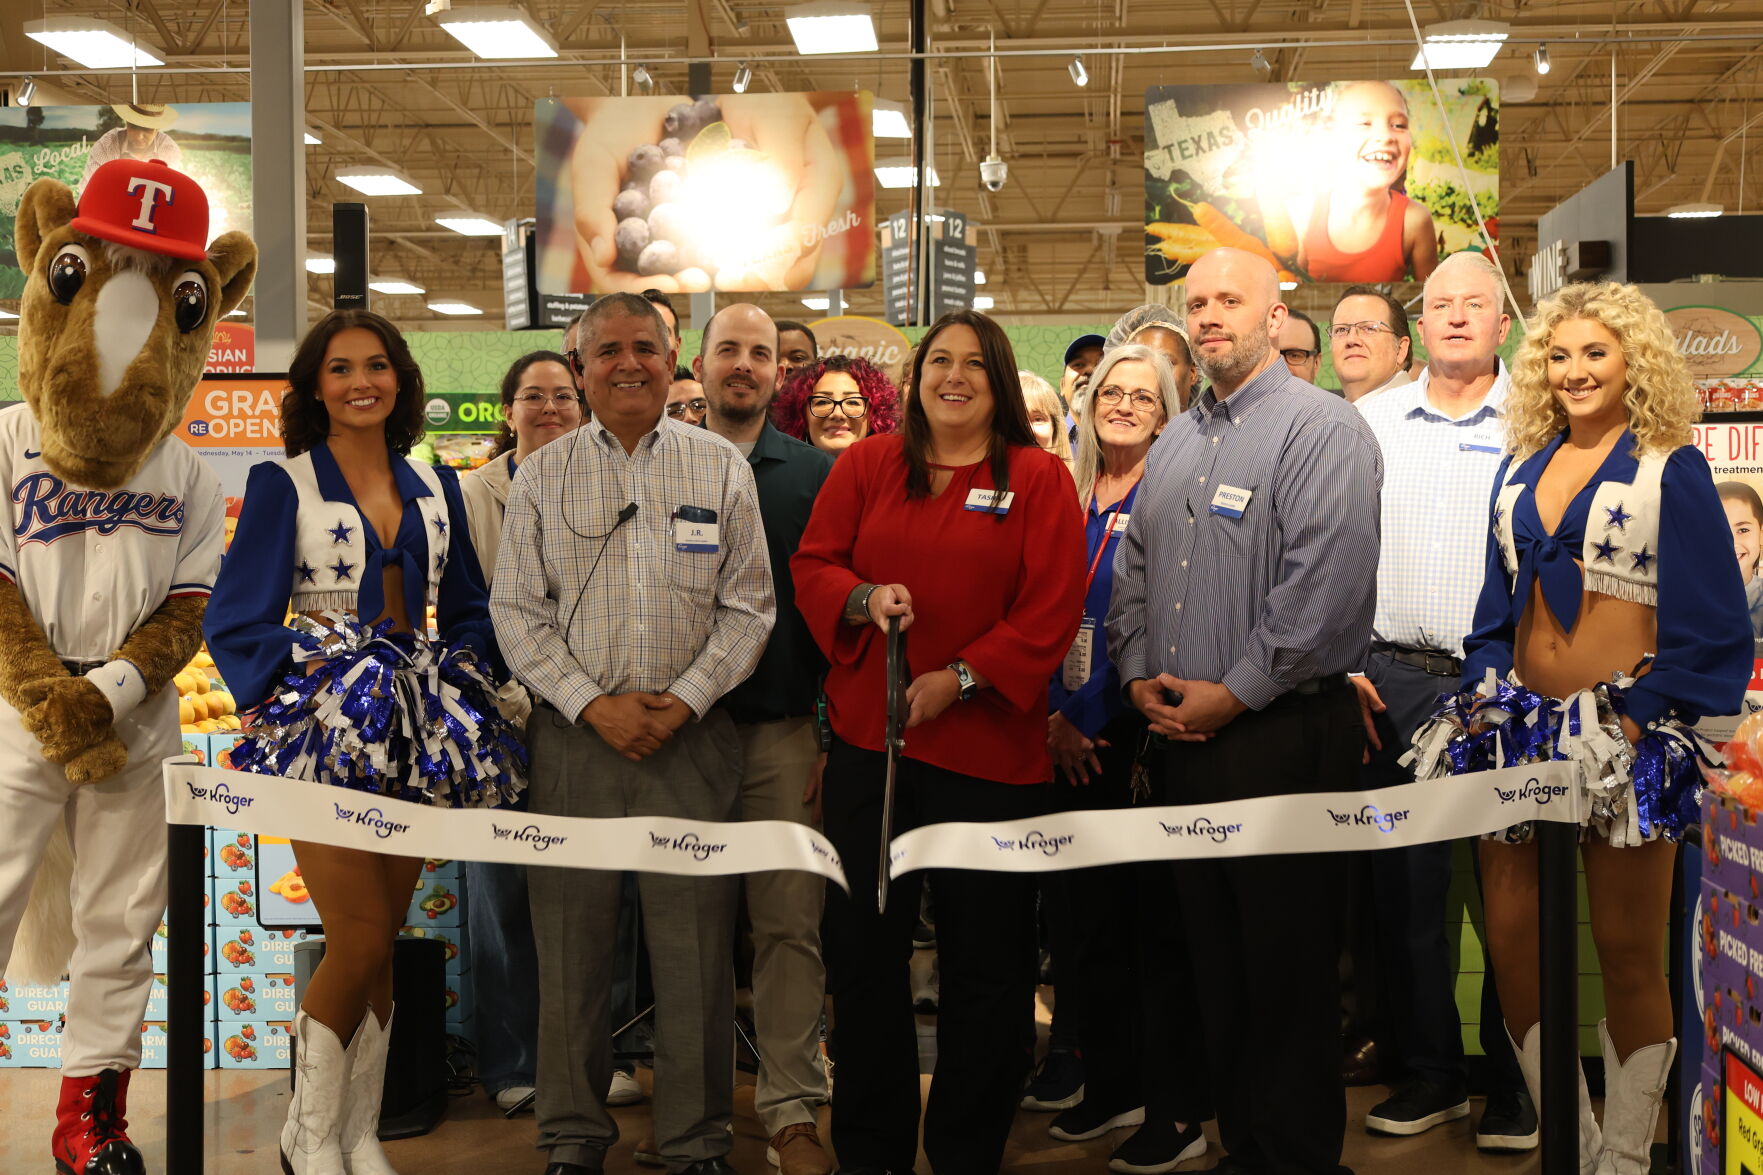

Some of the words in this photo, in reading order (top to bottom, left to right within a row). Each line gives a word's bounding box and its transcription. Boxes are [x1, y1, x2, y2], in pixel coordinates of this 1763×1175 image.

[1245, 86, 1335, 131] Quality
[33, 135, 92, 173] Local
[1162, 126, 1234, 164] TEXAS
[0, 163, 24, 185] AS
[127, 176, 175, 234] T
[800, 210, 861, 247] Fresh
[893, 218, 907, 240] 12
[948, 217, 963, 239] 12
[1532, 239, 1563, 304] WINE
[207, 348, 247, 363] SIAN
[817, 340, 901, 364] rganic
[1676, 330, 1743, 355] lads
[204, 390, 288, 417] GRA
[12, 471, 185, 536] Rangers
[1219, 491, 1245, 503] PRESTON
[210, 783, 254, 815] Kroger
[1519, 777, 1569, 805] Kroger
[355, 808, 410, 839] Kroger
[1187, 818, 1243, 843] Kroger
[1354, 805, 1410, 833] Kroger
[513, 825, 568, 851] Kroger
[672, 832, 728, 862] Kroger
[1019, 831, 1075, 856] Kroger
[1720, 834, 1749, 867] PICKED
[262, 940, 298, 951] DIREC
[1720, 929, 1748, 967] PICKED
[15, 987, 59, 999] DIRECT
[27, 1001, 67, 1011] GUAR
[262, 988, 295, 999] DIREC
[1744, 1079, 1760, 1111] LOW
[1738, 1116, 1751, 1143] Red
